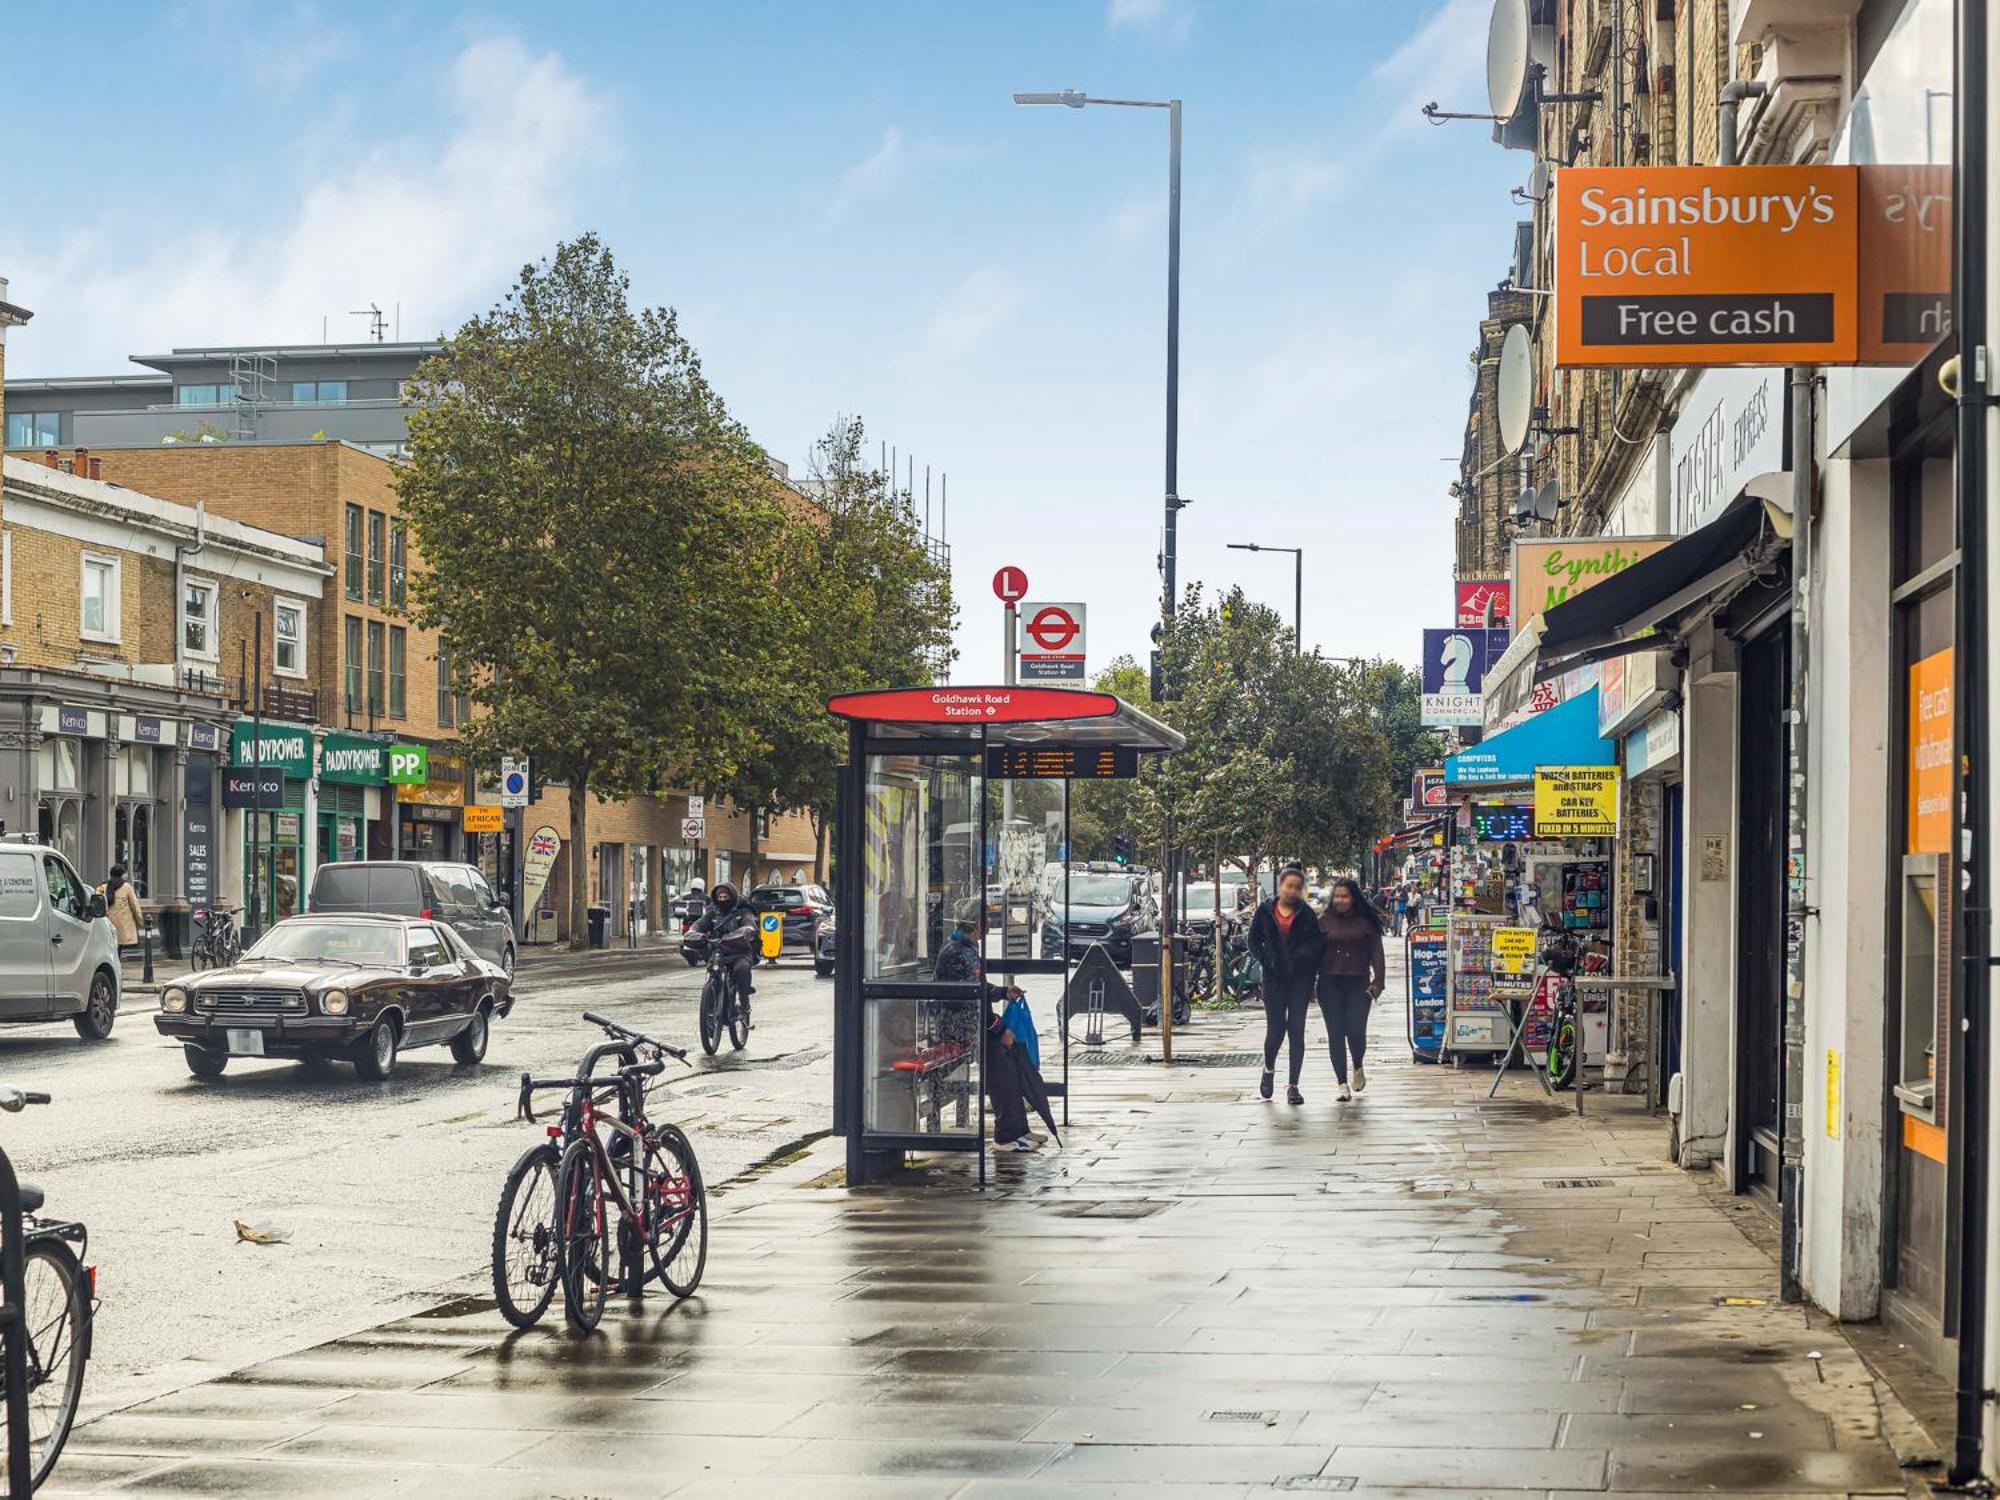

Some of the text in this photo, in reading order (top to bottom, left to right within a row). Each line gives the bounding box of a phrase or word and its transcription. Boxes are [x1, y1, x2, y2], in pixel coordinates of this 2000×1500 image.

[1580, 185, 1836, 233] Sainsbury's
[1580, 236, 1692, 277] Local
[1617, 300, 1796, 336] Free cash
[1003, 572, 1018, 597] L
[932, 694, 1011, 704] Goldhawk Road
[1426, 696, 1482, 707] KNIGHT
[945, 706, 981, 716] Station
[1426, 707, 1482, 715] COMMERCIAL
[1457, 755, 1497, 763] COMPUTERS
[1572, 771, 1615, 780] BATTERIES
[1569, 782, 1603, 791] STRAPS
[1561, 797, 1594, 806] CAR KEY
[1556, 808, 1600, 818] BATTERIES
[1540, 823, 1616, 833] FIXED IN 5 MINUTES
[189, 844, 207, 856] SALES
[1415, 998, 1445, 1007] London
